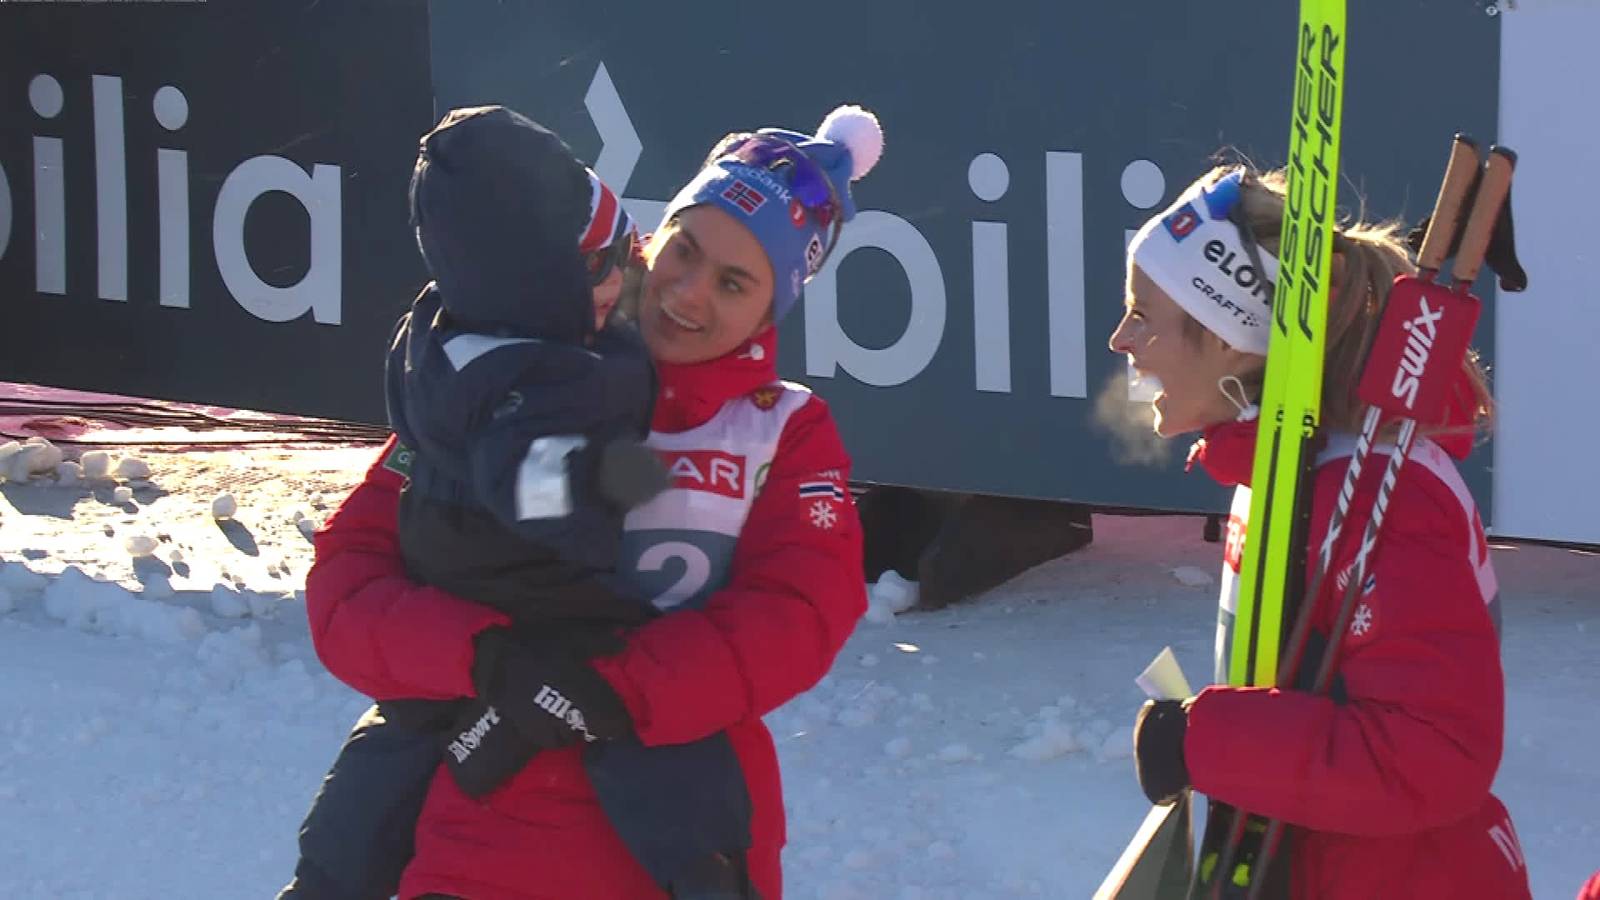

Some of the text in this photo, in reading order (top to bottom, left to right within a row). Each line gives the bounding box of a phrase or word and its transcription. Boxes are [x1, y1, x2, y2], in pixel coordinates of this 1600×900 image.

[0, 73, 342, 325] ilia
[1276, 22, 1316, 338] FISCHER
[1298, 24, 1339, 342] FISCHER
[1192, 277, 1245, 317] CRAFT
[670, 456, 741, 491] AR
[638, 541, 711, 611] 2
